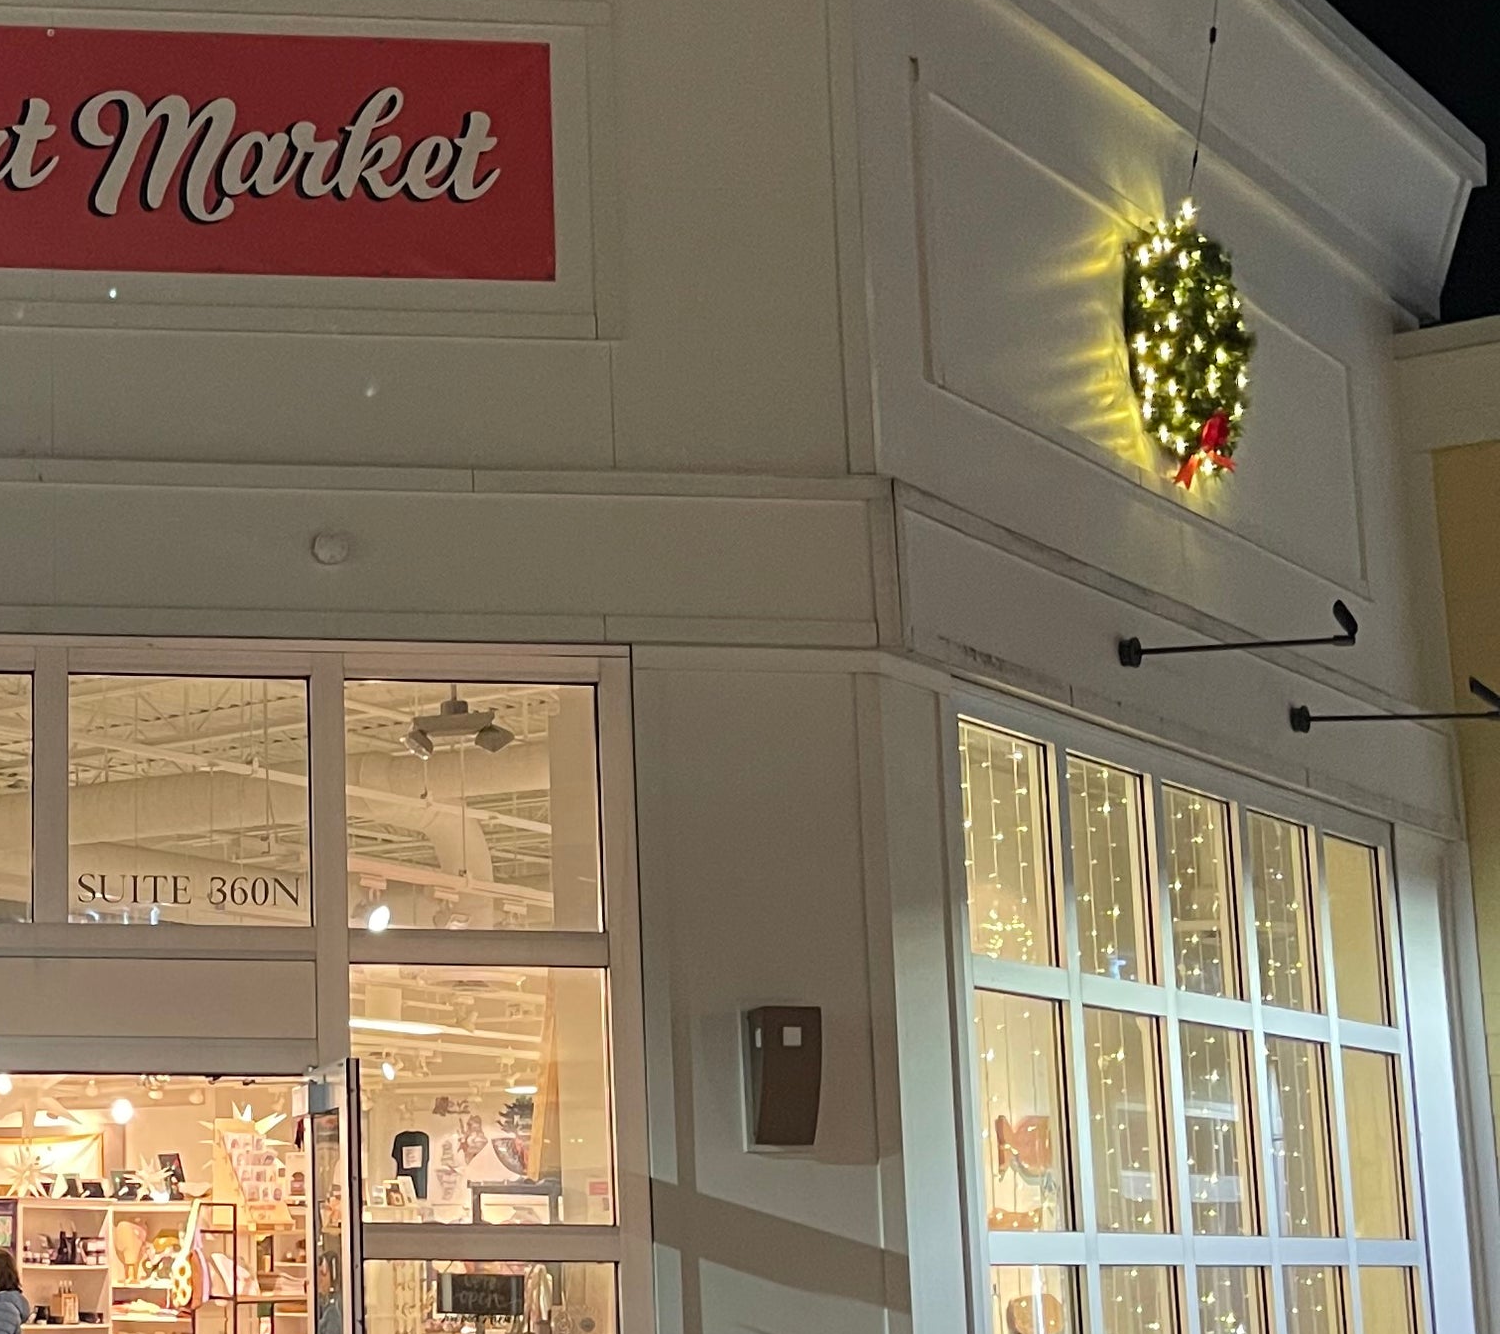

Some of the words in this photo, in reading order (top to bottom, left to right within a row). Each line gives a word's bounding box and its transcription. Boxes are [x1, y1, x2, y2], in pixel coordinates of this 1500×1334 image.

[69, 86, 500, 226] Market
[76, 873, 192, 905] SUITE
[206, 875, 300, 907] 360N
